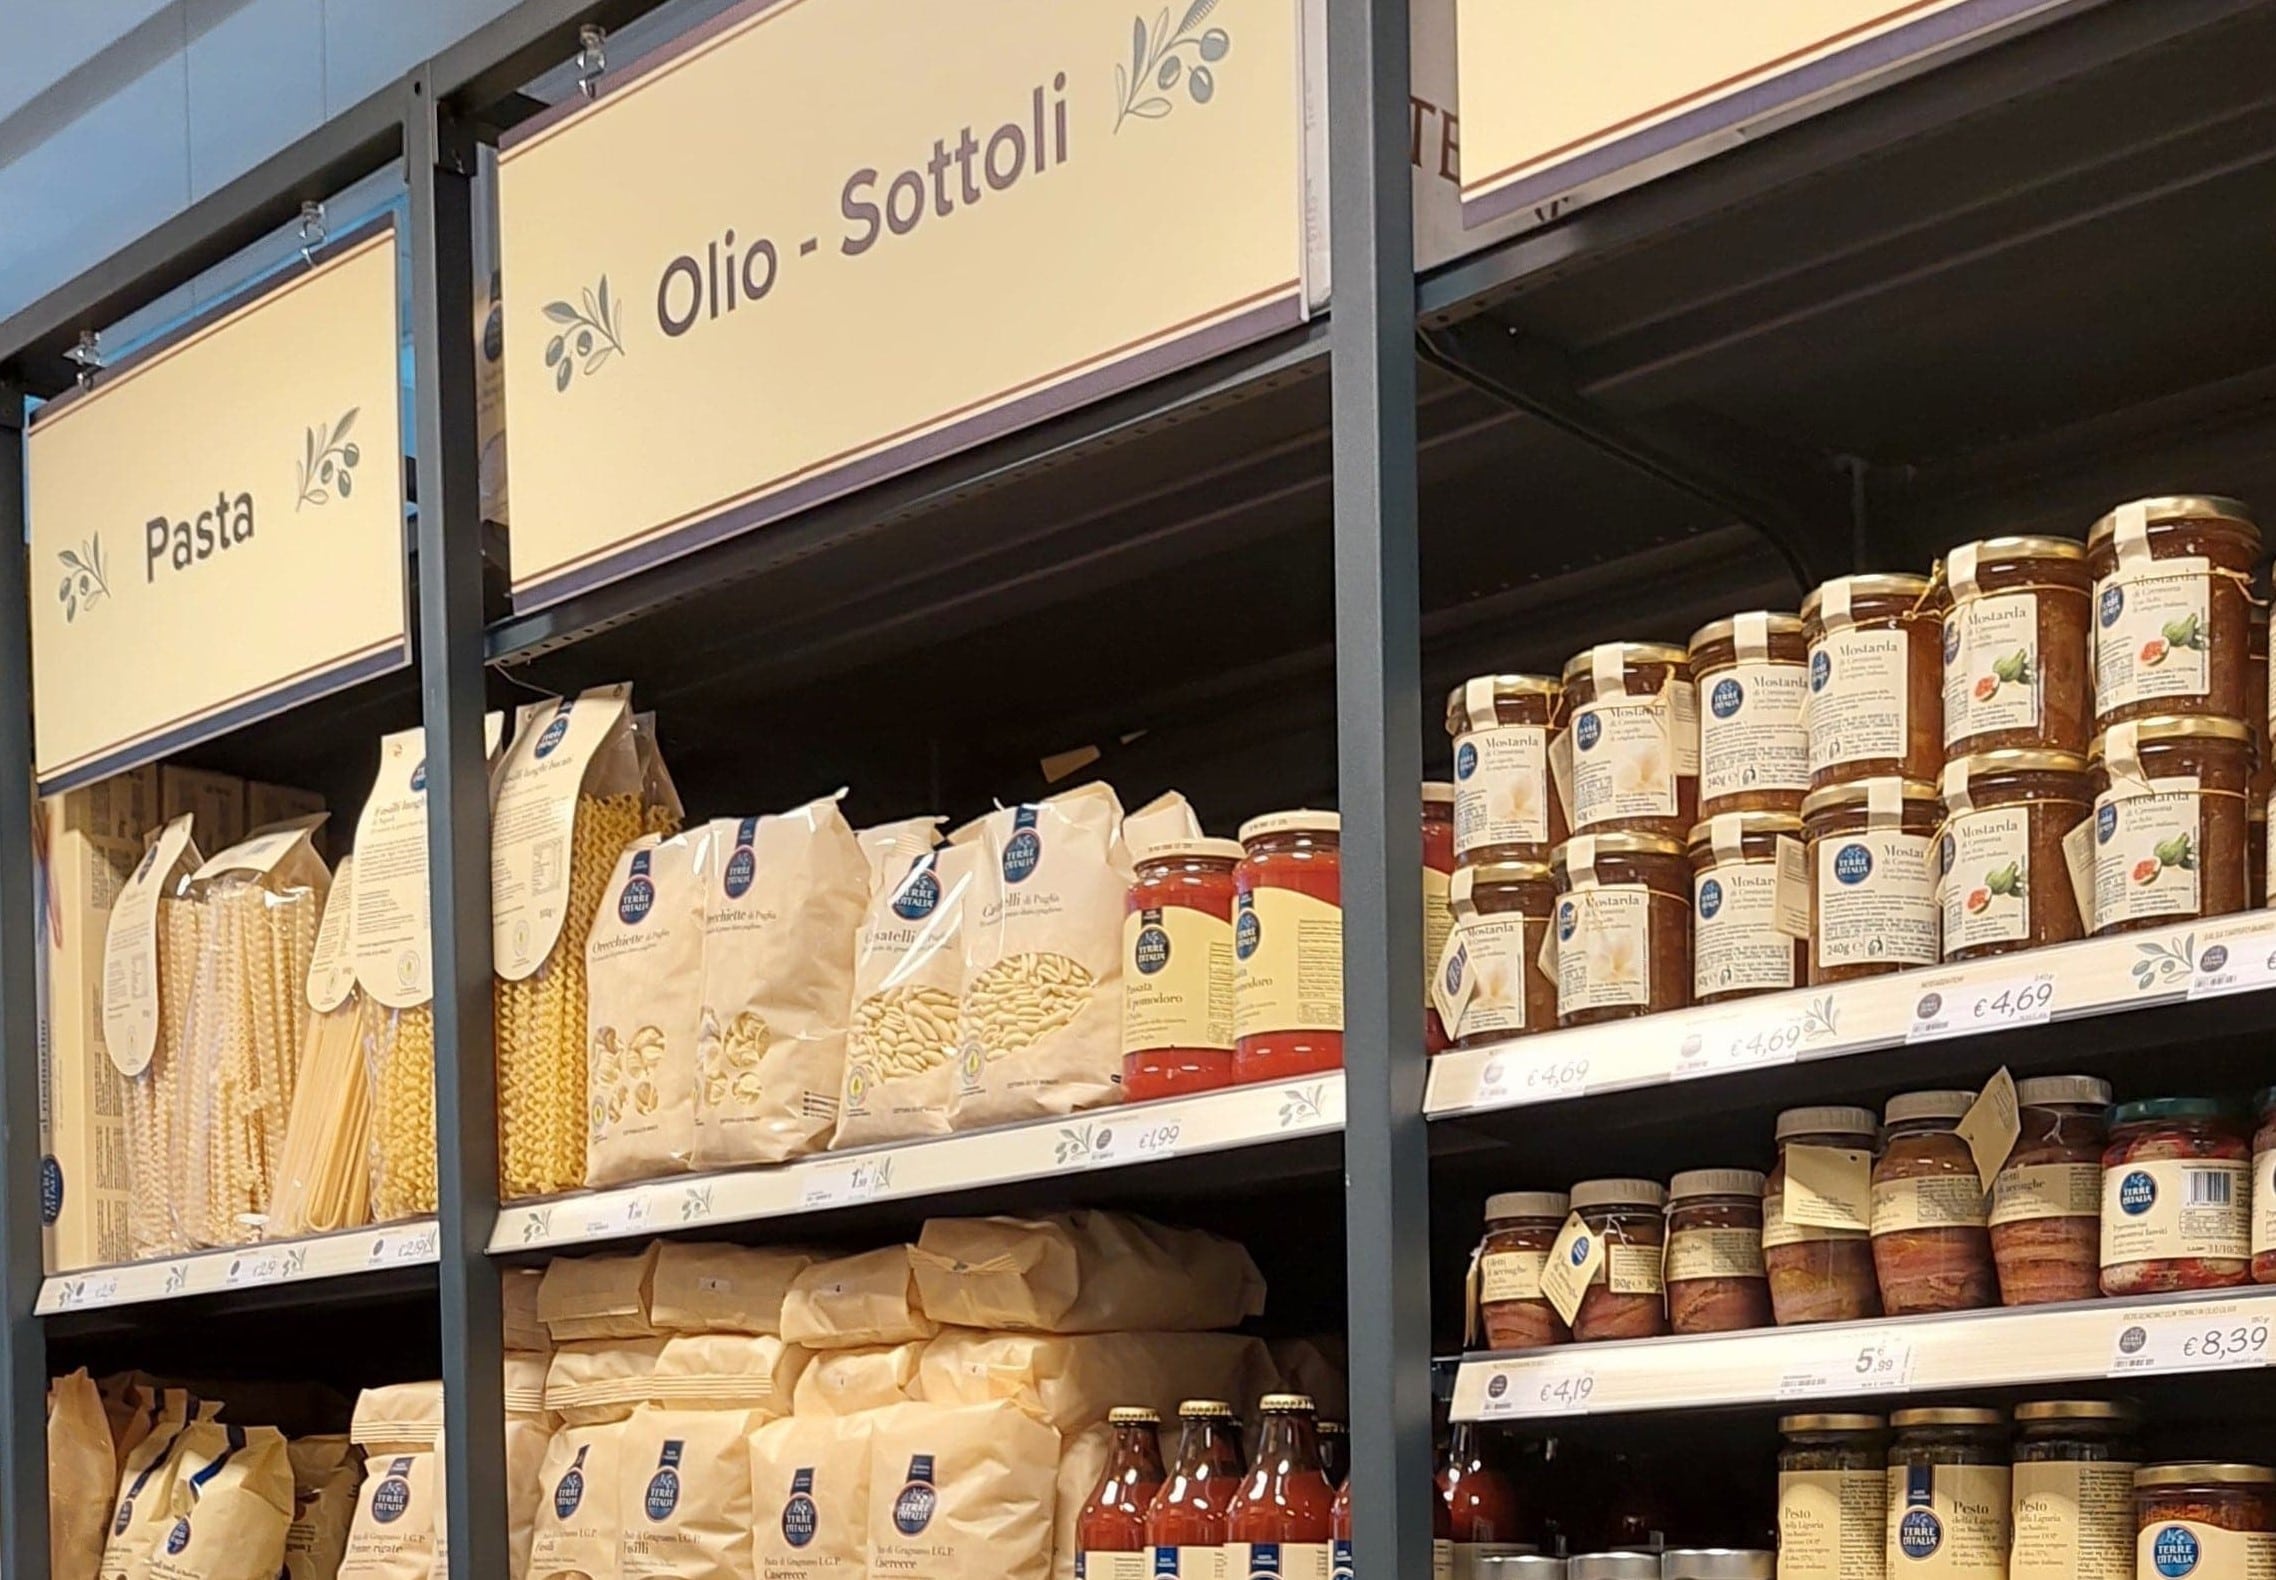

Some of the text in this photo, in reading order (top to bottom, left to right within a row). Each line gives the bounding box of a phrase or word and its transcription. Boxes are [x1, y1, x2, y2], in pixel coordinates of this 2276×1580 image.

[656, 228, 777, 338] Olio
[840, 71, 1068, 257] Sottoli
[145, 490, 256, 583] Pasta
[1968, 605, 2026, 625] Mostarda
[1840, 640, 1898, 656] Mostarda
[1486, 735, 1539, 748] Mostarda
[1962, 819, 2018, 838] Mostarda
[1974, 983, 2053, 1018] €4,69
[2123, 1186, 2150, 1196] TERRE
[2183, 1326, 2268, 1360] €8,39
[1954, 1501, 1990, 1514] Pesto
[2020, 1499, 2047, 1512] Pesto
[1785, 1507, 1812, 1520] Pesto
[1903, 1527, 1936, 1536] TERRE
[2158, 1545, 2193, 1554] TERRE
